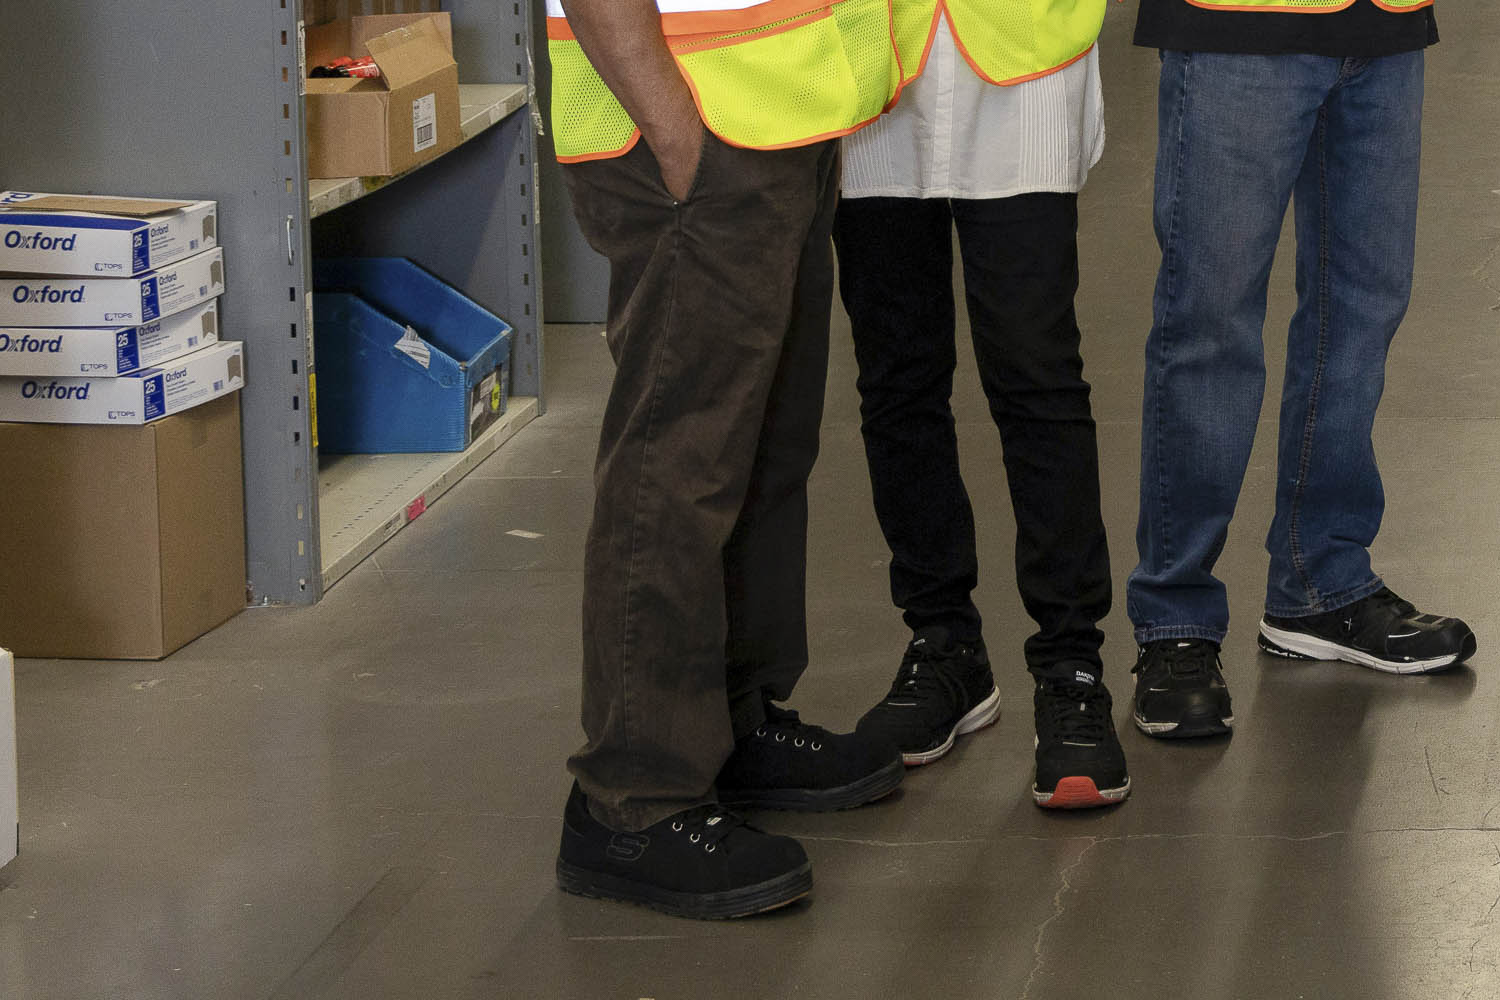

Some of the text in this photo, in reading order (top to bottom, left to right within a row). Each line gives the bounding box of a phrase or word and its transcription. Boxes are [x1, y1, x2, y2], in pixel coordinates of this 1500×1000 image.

[4, 230, 77, 251] Oxford
[133, 234, 143, 247] 25
[12, 285, 85, 304] Oxford
[142, 281, 151, 296] 25
[0, 334, 63, 353] Oxford
[117, 334, 128, 347] 25
[166, 367, 187, 382] Oxford
[21, 380, 90, 400] Oxford
[145, 379, 156, 394] 25
